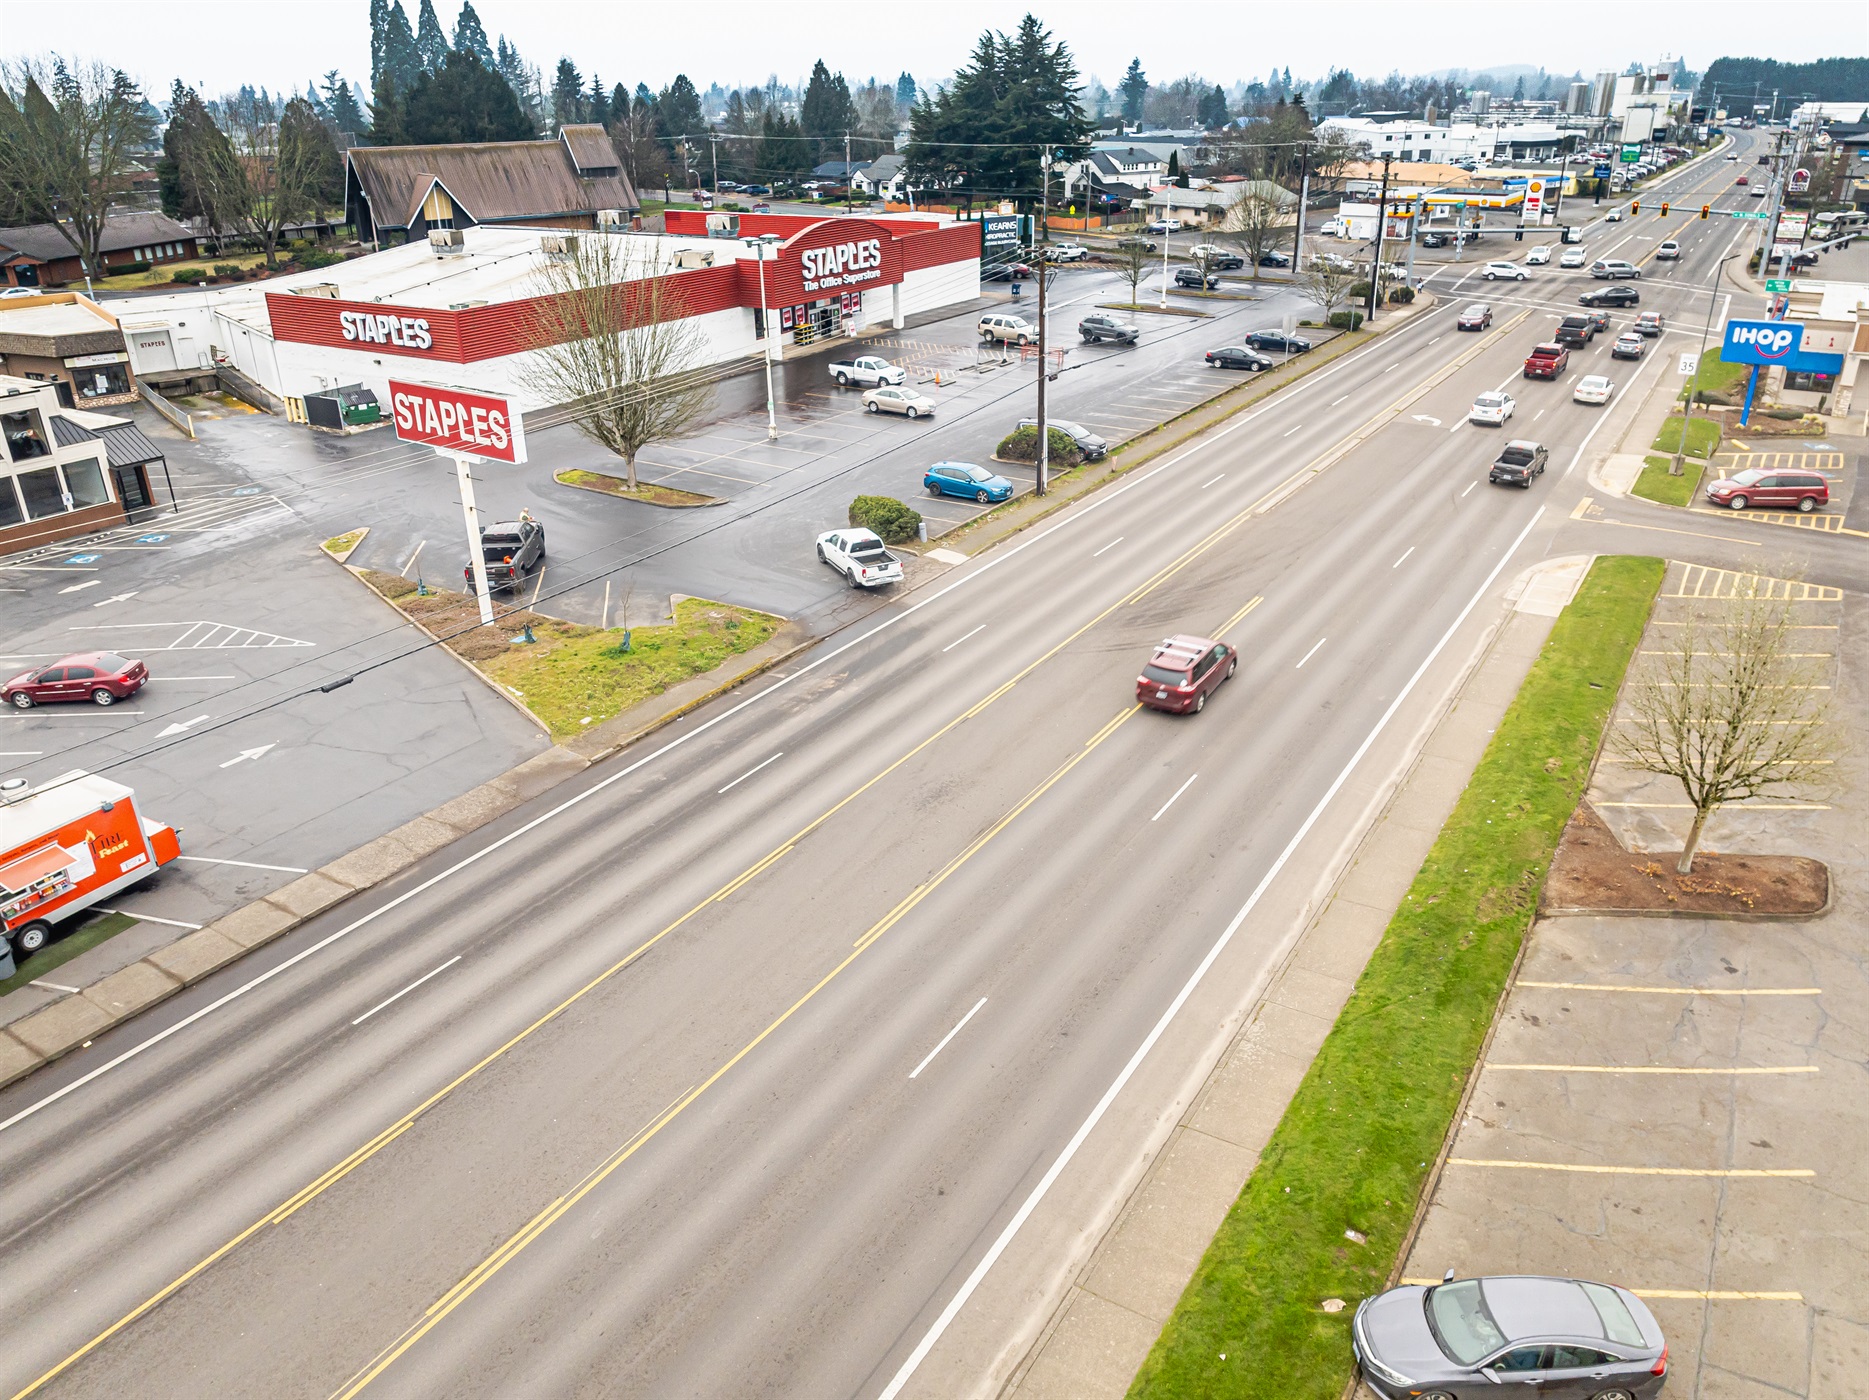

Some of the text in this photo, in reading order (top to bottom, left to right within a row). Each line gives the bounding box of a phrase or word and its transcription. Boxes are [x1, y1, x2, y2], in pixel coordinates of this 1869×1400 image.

[988, 221, 1017, 231] KEARNS
[802, 239, 881, 279] STAPLES
[803, 270, 881, 291] The Office Superstore
[340, 311, 432, 349] STAPLES
[1732, 327, 1793, 352] IHOP
[1680, 361, 1695, 372] 35
[394, 392, 508, 449] STAPLES
[98, 839, 129, 859] Feast
